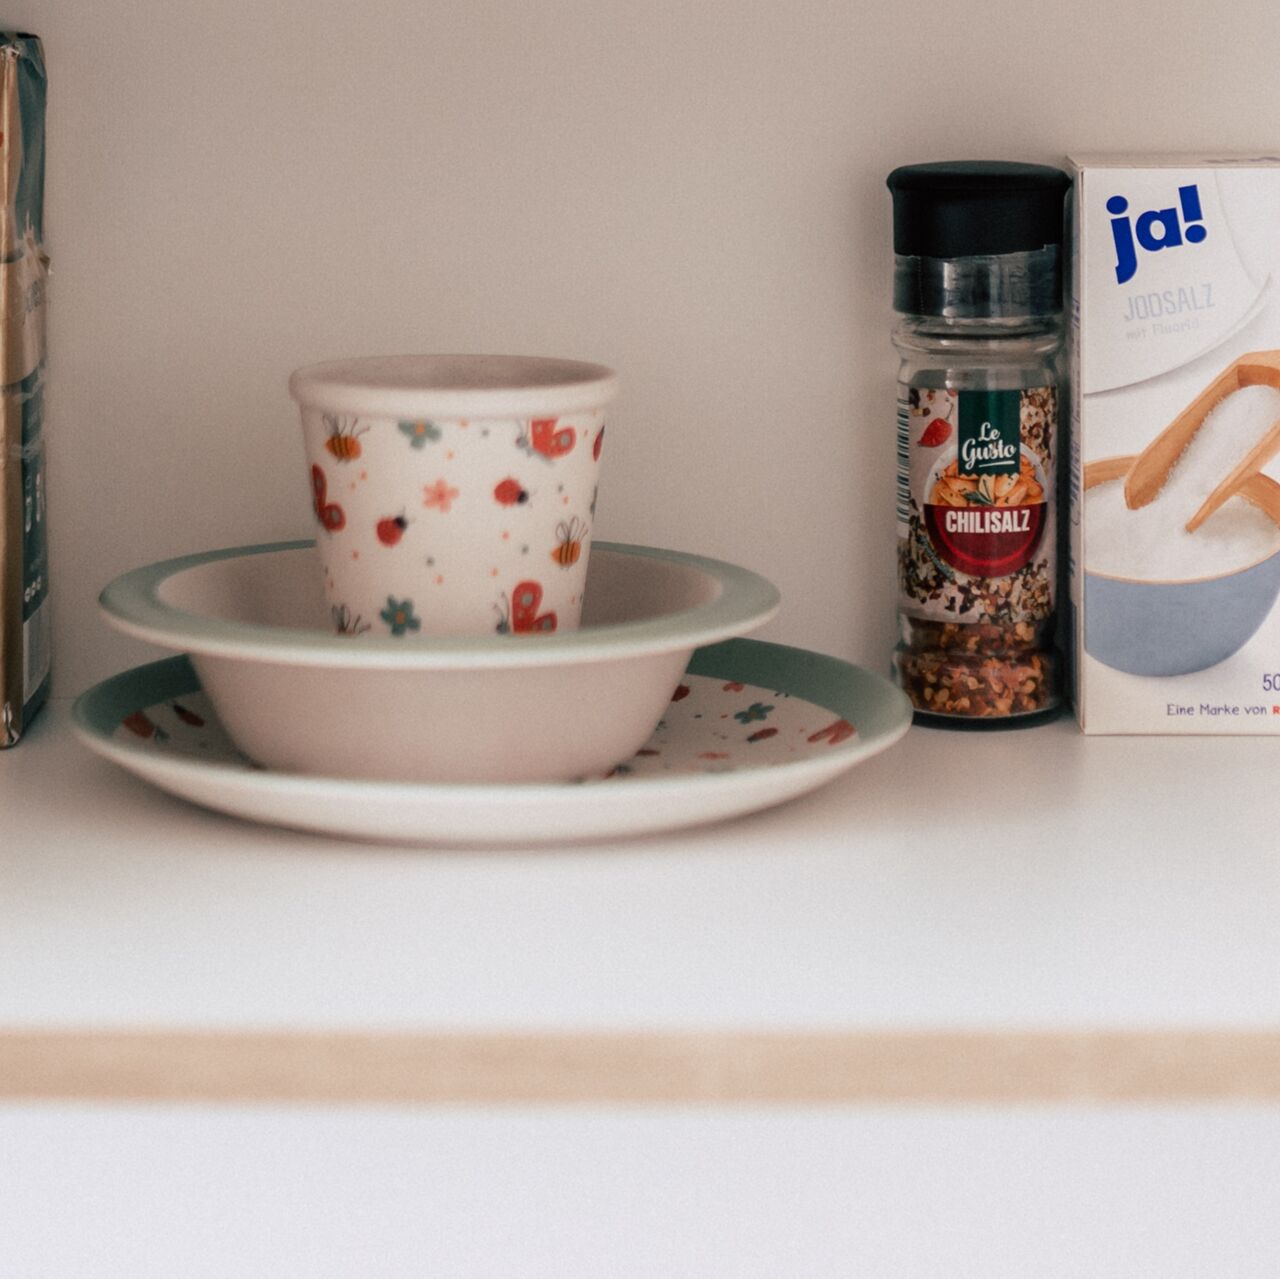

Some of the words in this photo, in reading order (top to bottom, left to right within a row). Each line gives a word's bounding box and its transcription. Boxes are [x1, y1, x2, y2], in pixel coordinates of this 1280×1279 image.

[1106, 184, 1208, 285] ja!
[1123, 283, 1216, 322] JODSALZ
[978, 422, 1000, 442] Le
[962, 438, 1017, 470] Gusto
[945, 509, 1030, 533] CHILISALZ
[1166, 703, 1195, 716] Eine
[1199, 703, 1240, 716] Marke
[1244, 705, 1267, 715] von
